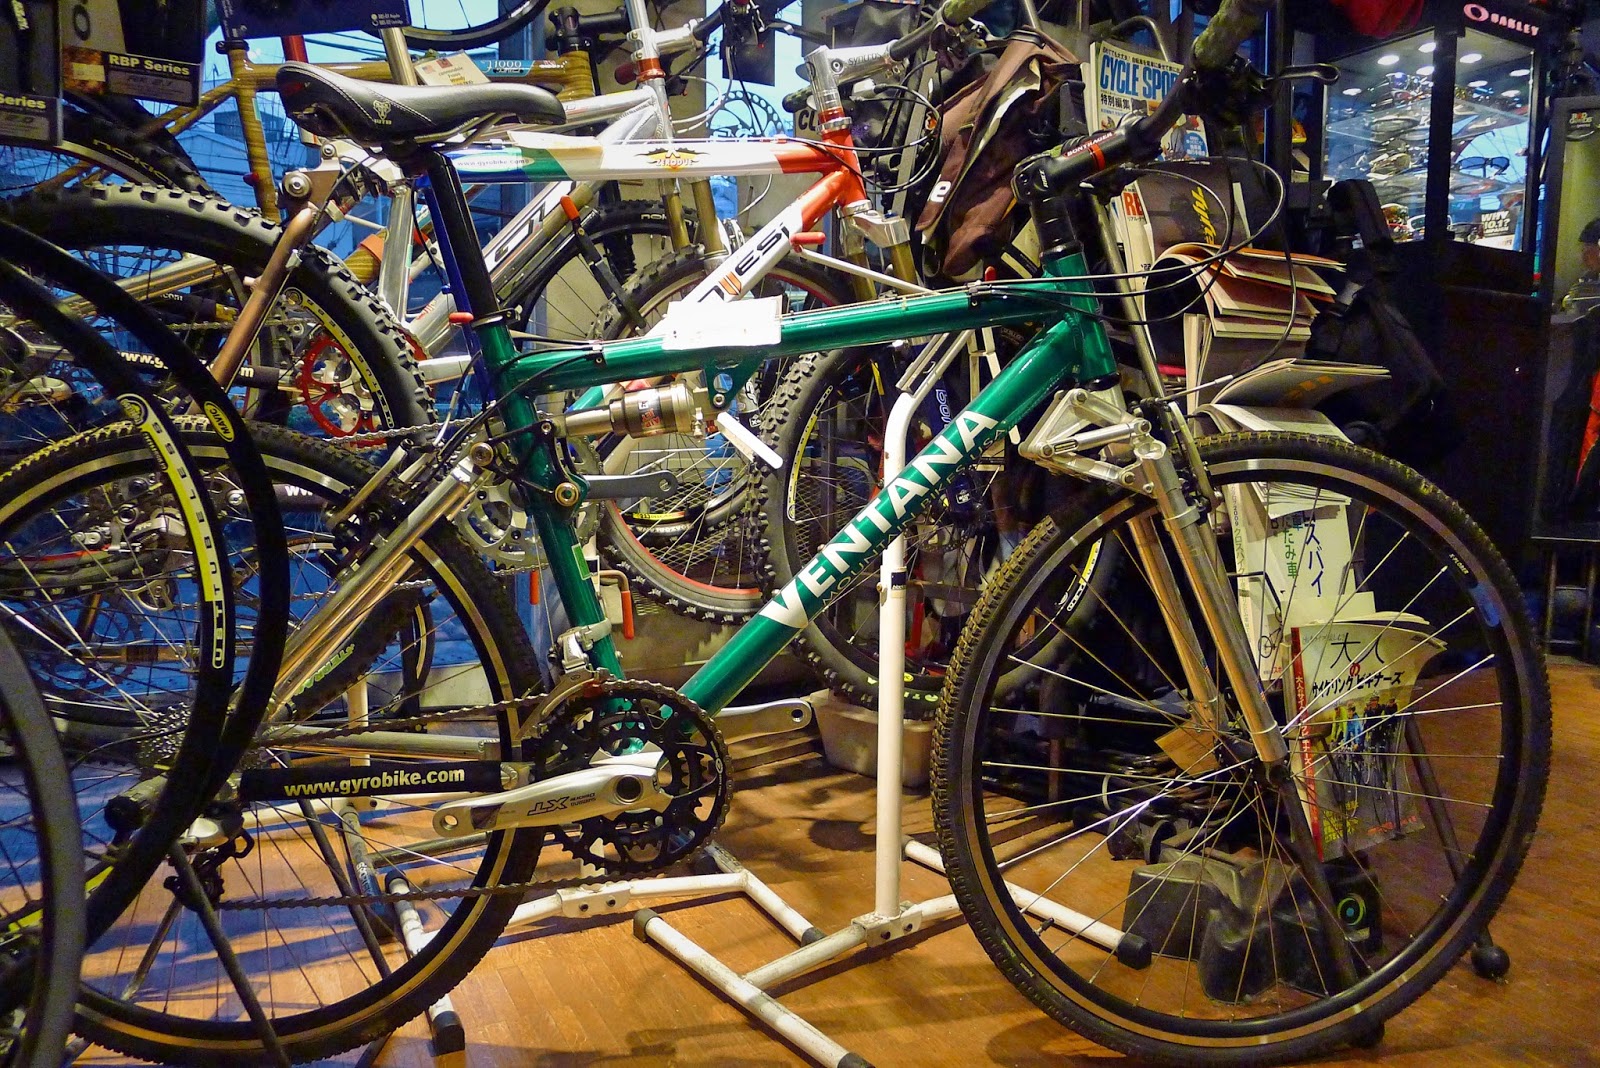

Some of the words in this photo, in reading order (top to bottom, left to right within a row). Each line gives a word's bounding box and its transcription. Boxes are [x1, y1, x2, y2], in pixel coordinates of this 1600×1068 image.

[1490, 13, 1539, 36] OAKLEY
[109, 54, 140, 68] RBP
[144, 59, 190, 76] Series
[1100, 54, 1140, 97] CYCLE
[1066, 132, 1113, 157] BONTRAGER
[1481, 211, 1509, 222] WHY
[209, 408, 232, 435] MAVIC
[759, 410, 999, 629] VENTANA
[822, 514, 912, 606] MOUNTAIN
[970, 429, 1007, 462] USA
[1329, 632, 1385, 670] 大人
[284, 768, 465, 797] www.gyrobike.com
